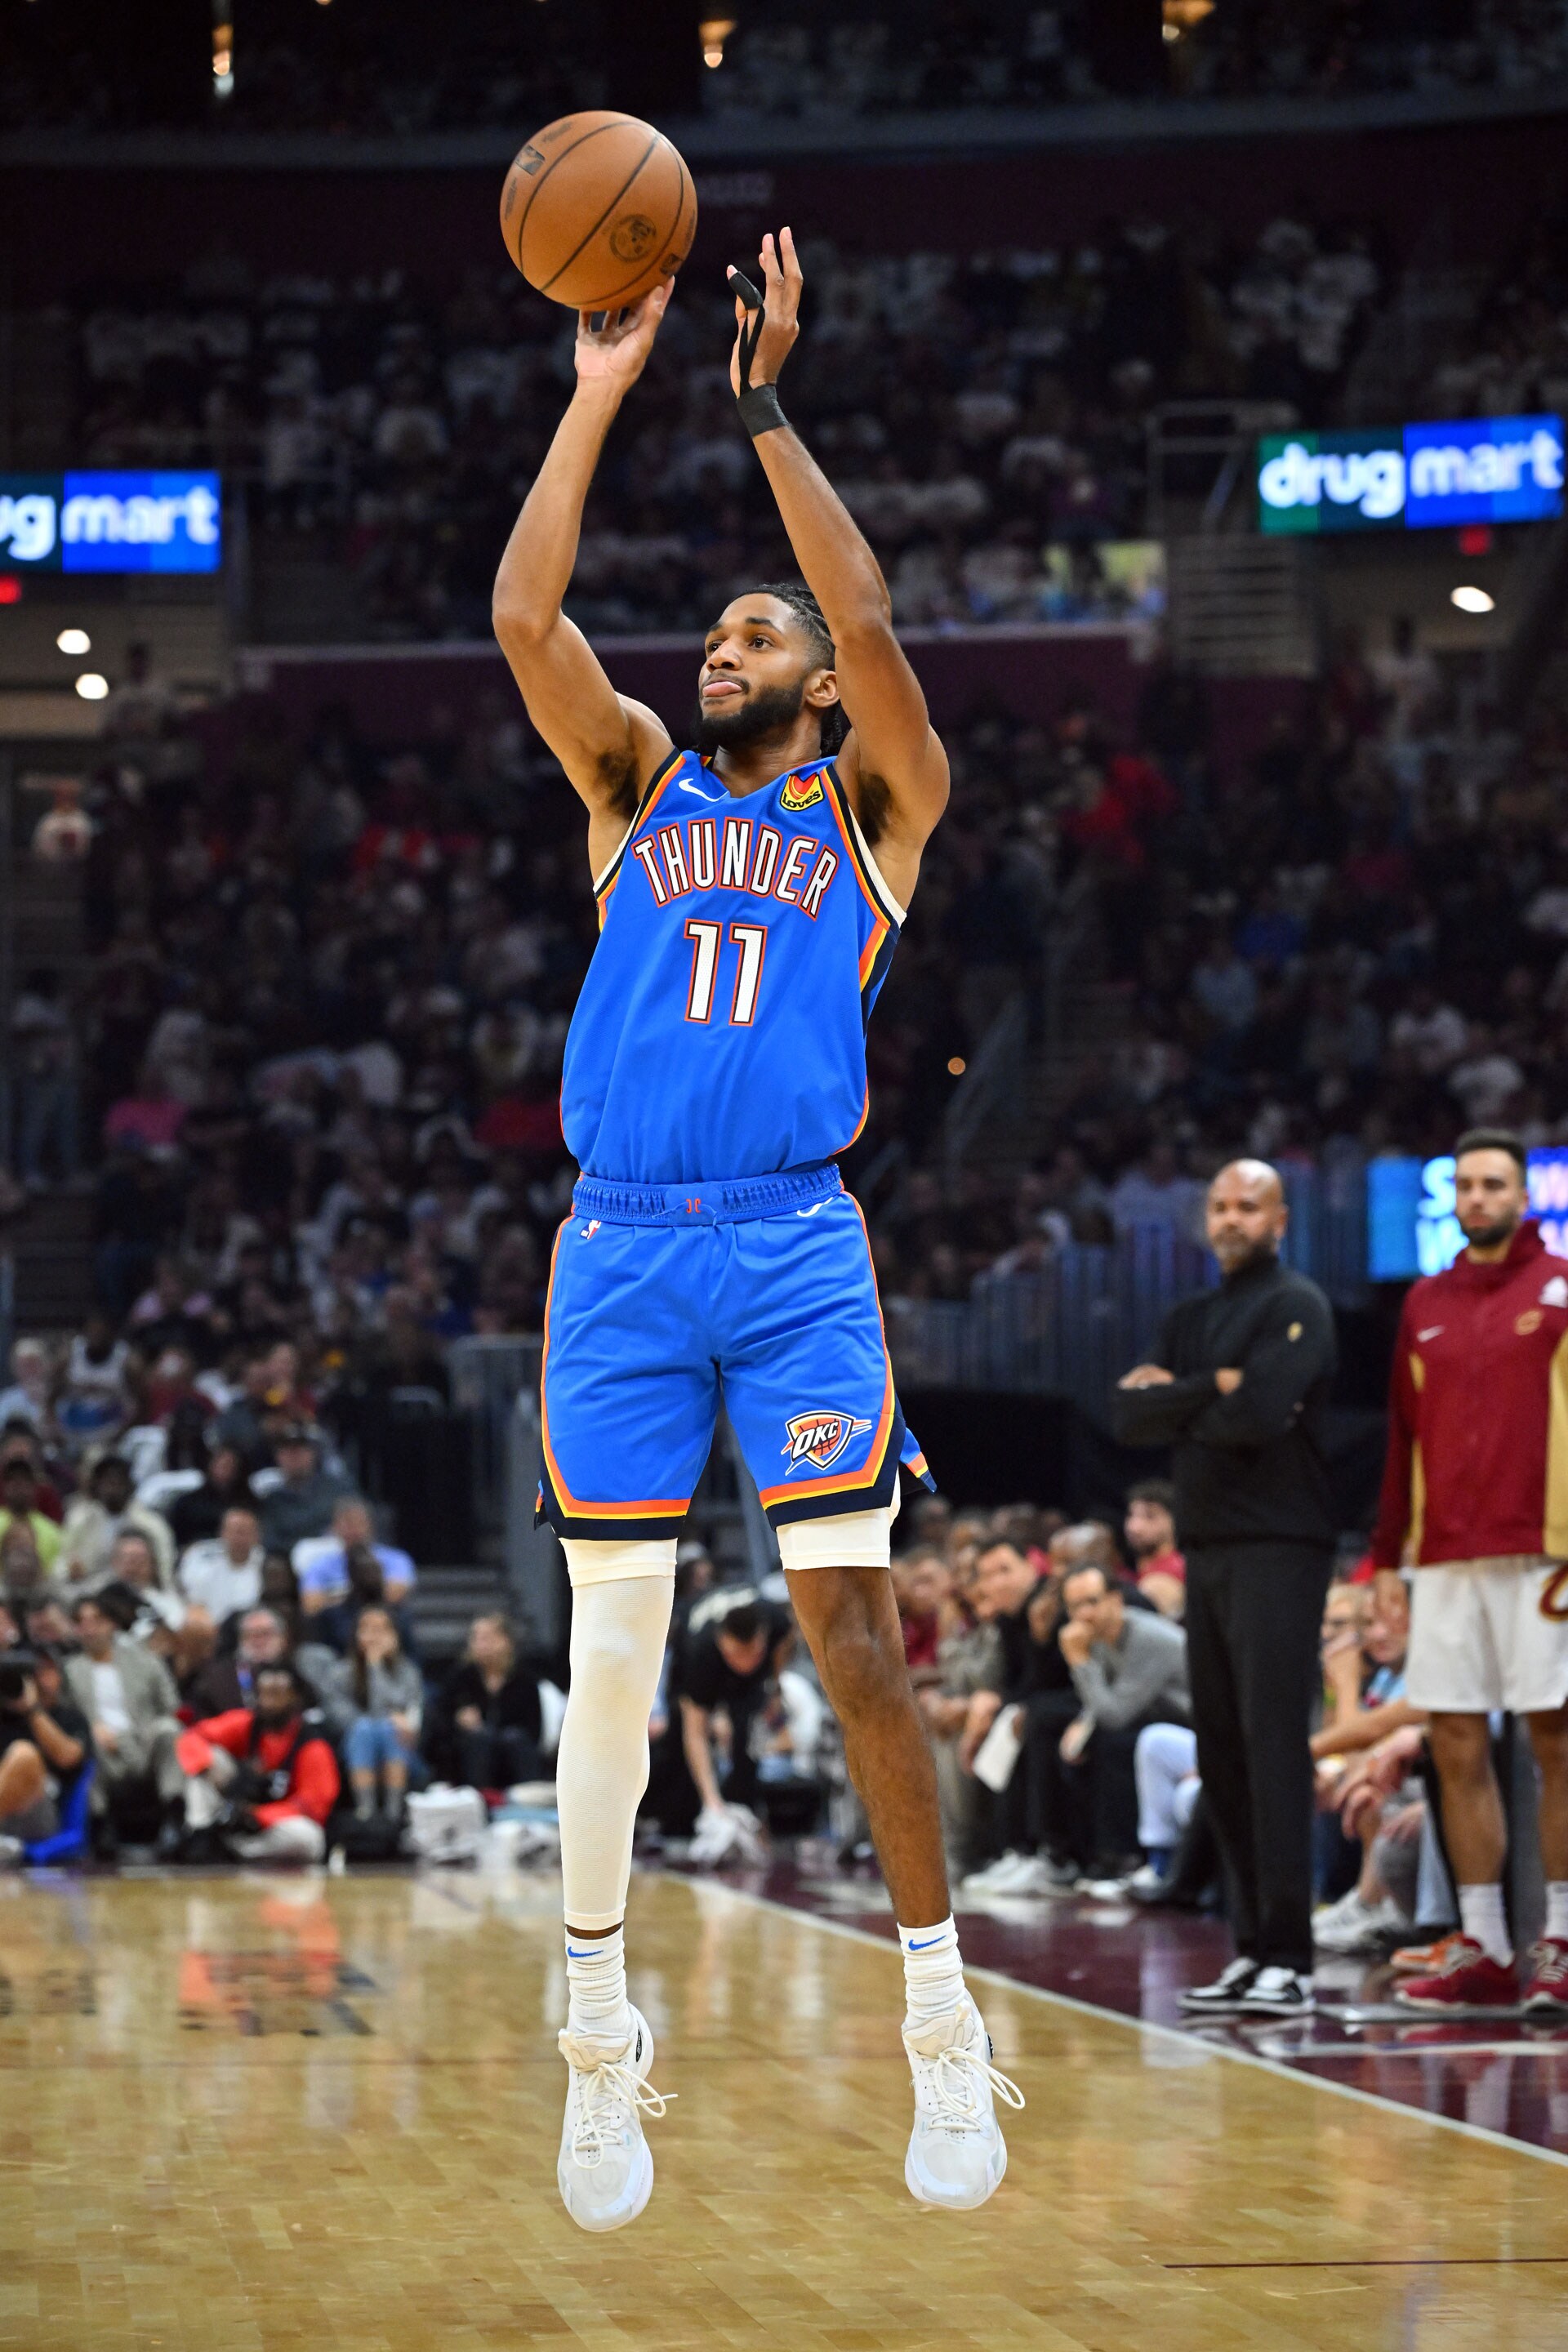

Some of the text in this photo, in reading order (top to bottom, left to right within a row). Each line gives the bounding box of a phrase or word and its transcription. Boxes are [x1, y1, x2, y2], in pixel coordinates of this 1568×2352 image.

[60, 485, 219, 545] mart
[1258, 429, 1564, 519] drug mart
[631, 817, 839, 921] THUNDER
[684, 918, 768, 1027] 11
[791, 1421, 840, 1460] OKC
